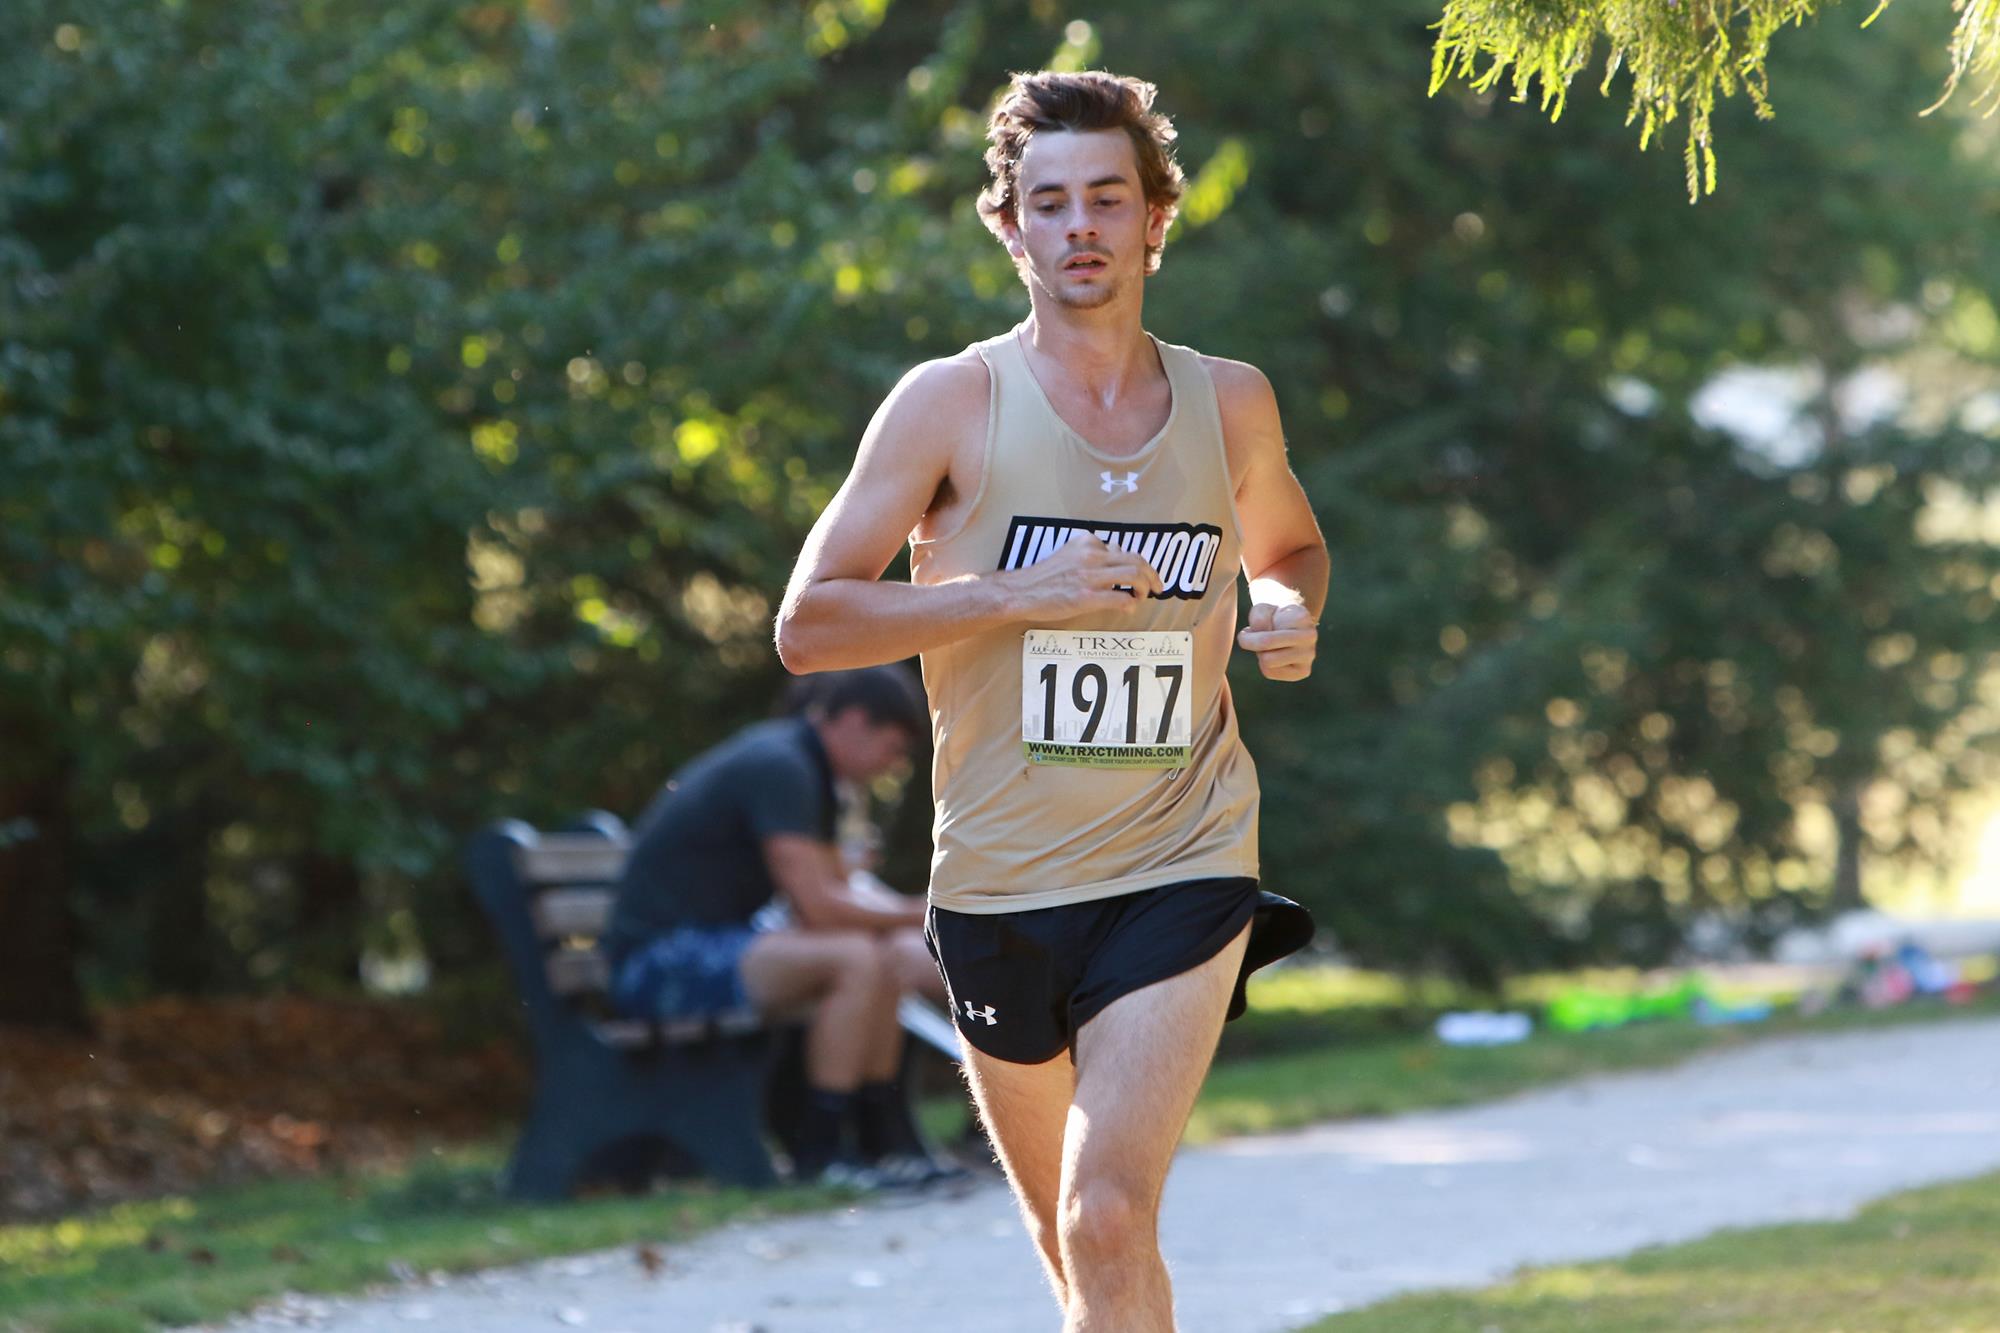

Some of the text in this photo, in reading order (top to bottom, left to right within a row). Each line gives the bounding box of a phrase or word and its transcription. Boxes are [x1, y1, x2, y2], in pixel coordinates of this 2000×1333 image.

[1003, 525, 1220, 592] LIWOOD
[1072, 636, 1146, 650] TRXC
[1040, 663, 1183, 744] 1917
[1028, 742, 1184, 757] WWW.TRXCTIMING.COM
